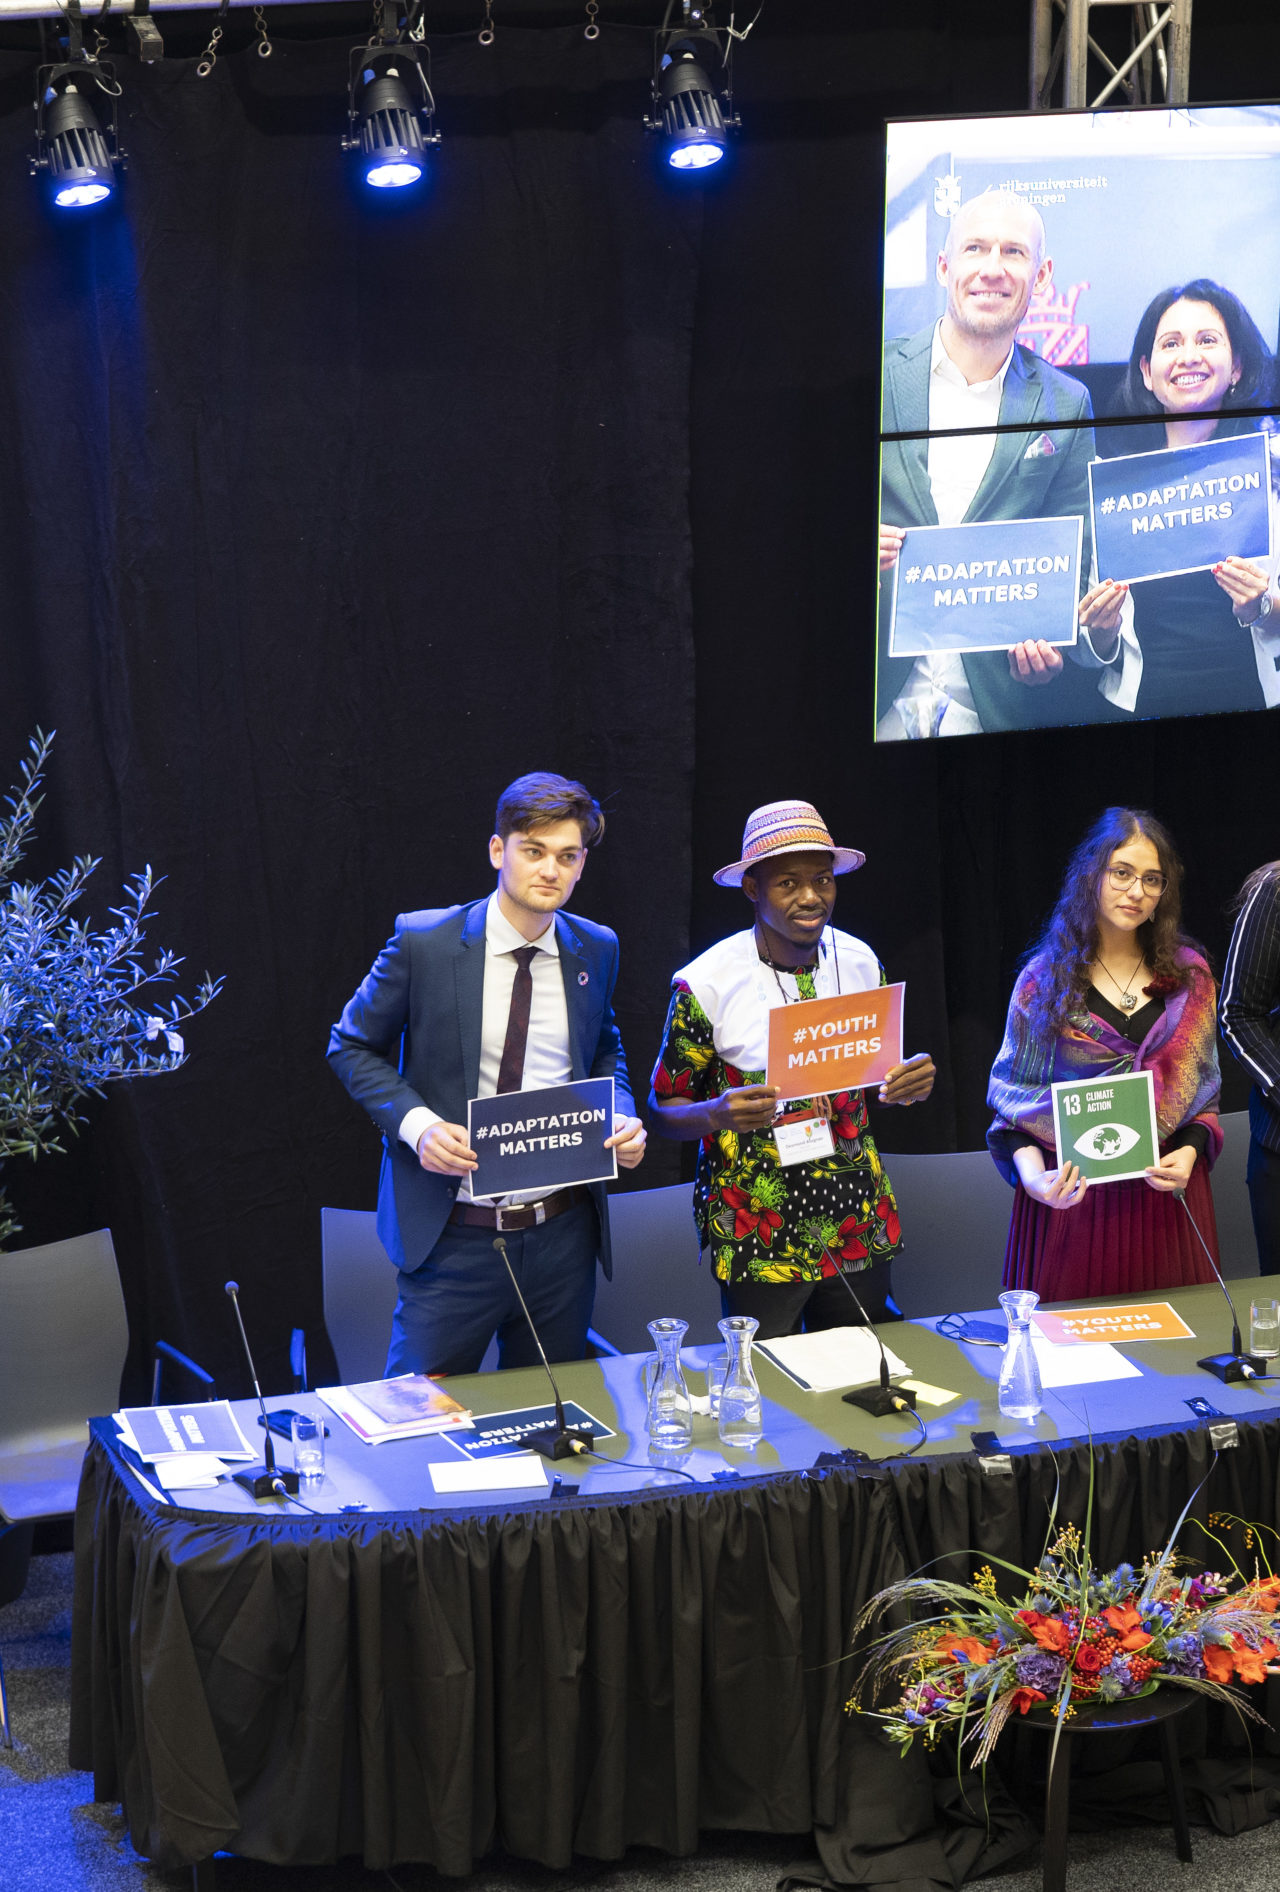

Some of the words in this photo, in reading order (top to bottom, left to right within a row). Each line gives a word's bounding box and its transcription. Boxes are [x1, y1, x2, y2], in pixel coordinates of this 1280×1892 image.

[999, 176, 1108, 192] rijksuniversiteit
[1100, 472, 1260, 515] #ADAPTATION
[1131, 502, 1233, 535] MATTERS
[905, 555, 1071, 584] #ADAPTATION
[934, 582, 1038, 607] MATTERS
[793, 1013, 877, 1045] #YOUTH
[788, 1036, 882, 1069] MATTERS
[1063, 1094, 1081, 1117] 13
[1086, 1088, 1114, 1102] CLIMATE
[1087, 1100, 1112, 1113] ACTION
[475, 1108, 606, 1140] #ADAPTATION
[499, 1131, 583, 1157] MATTERS
[1061, 1313, 1151, 1327] #YOUTH
[1061, 1321, 1163, 1335] MATTERS
[464, 1421, 594, 1451] #AATION
